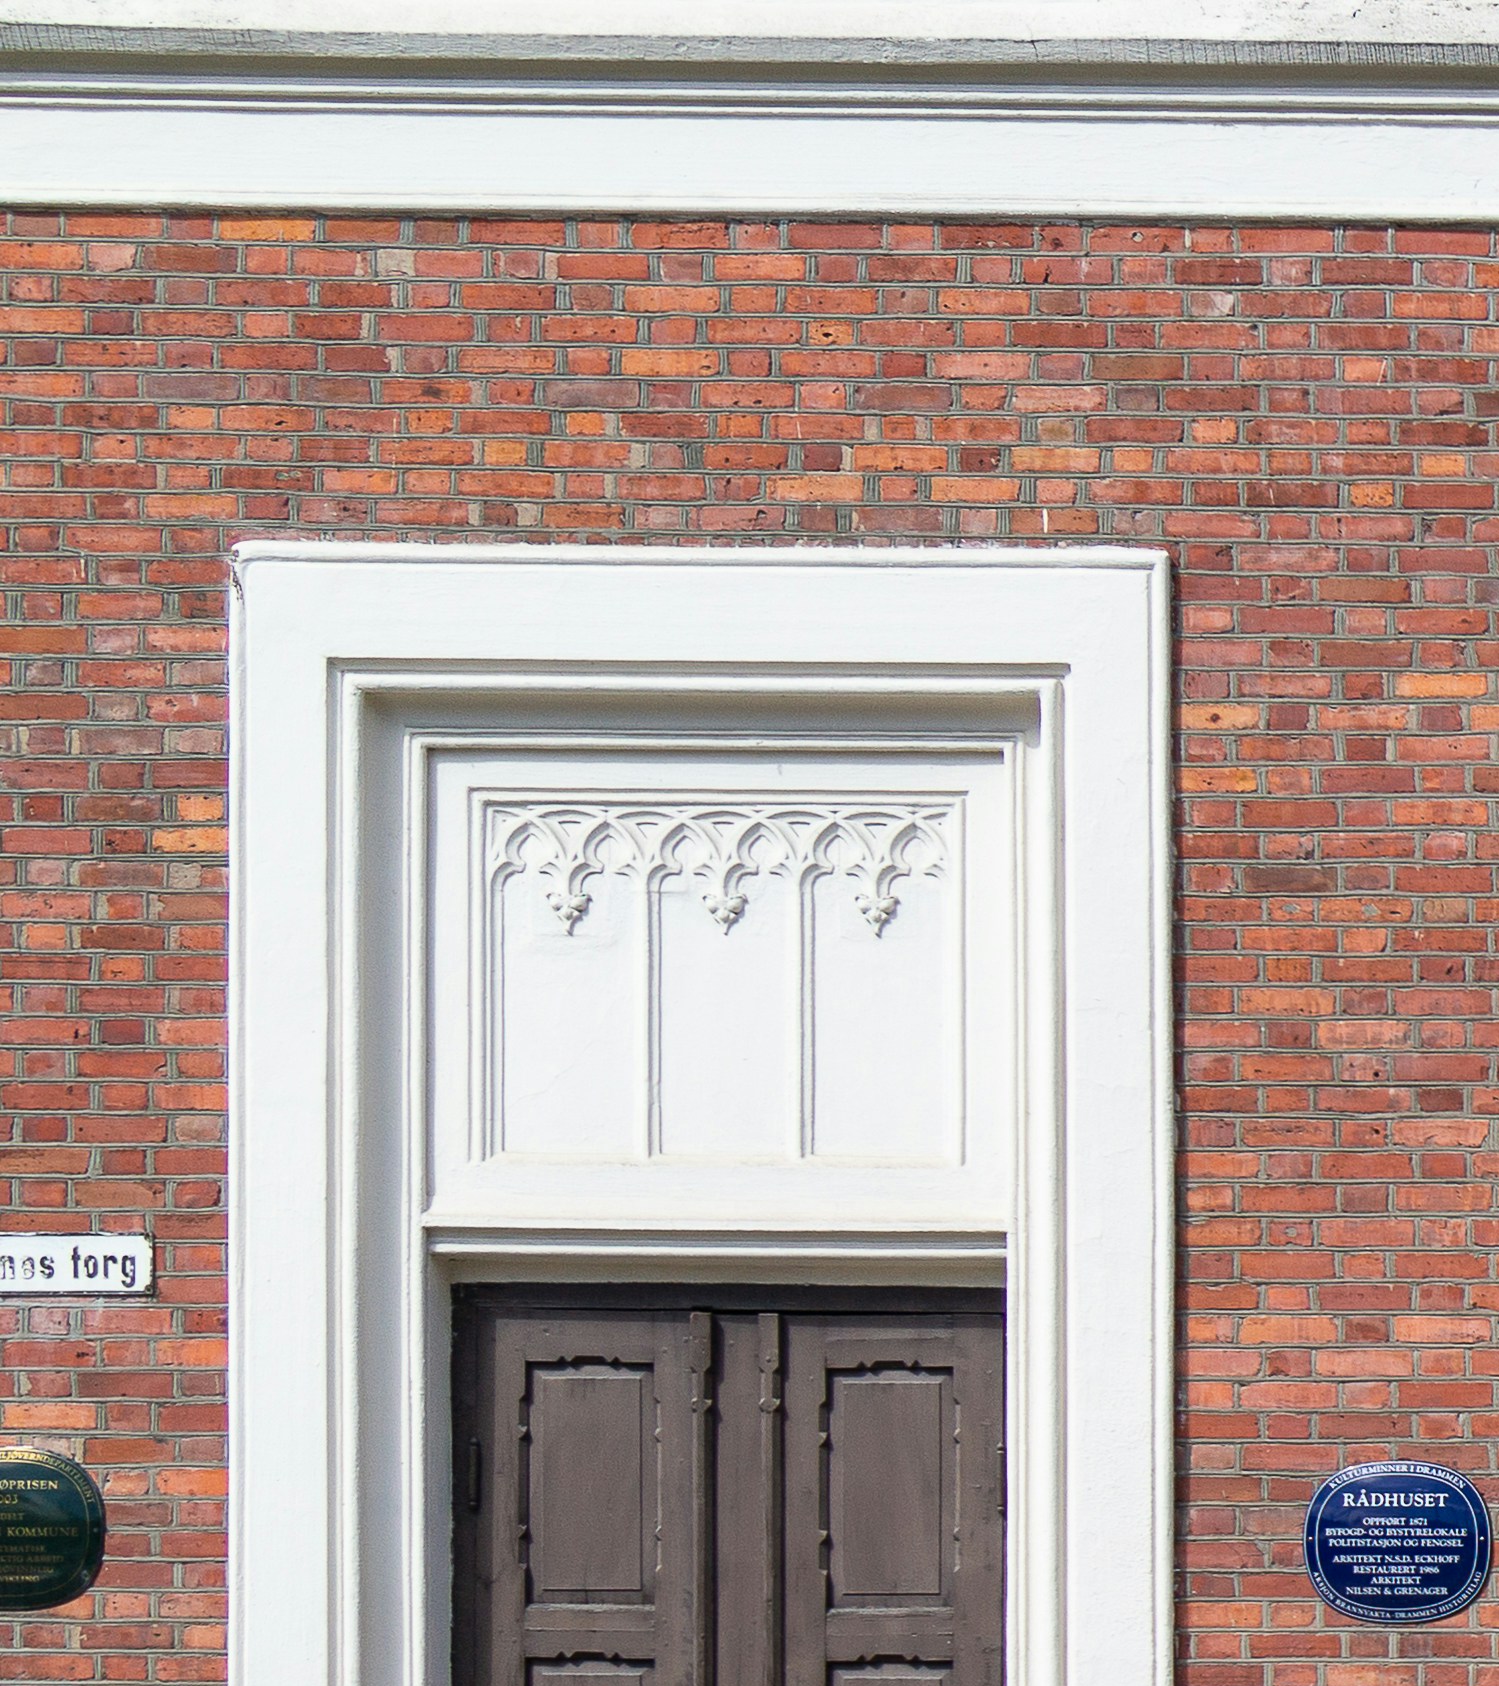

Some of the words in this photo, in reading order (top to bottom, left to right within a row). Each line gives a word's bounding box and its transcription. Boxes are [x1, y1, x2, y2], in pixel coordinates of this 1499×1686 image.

[71, 1245, 137, 1289] torg
[1328, 1465, 1408, 1489] KULTURMINNER
[1409, 1465, 1415, 1473] I
[1416, 1465, 1467, 1489] DRAMMEN
[1342, 1488, 1449, 1507] RÅDHUSET
[7, 1526, 80, 1537] KOMMUNE
[1325, 1527, 1368, 1537] BYFOGD-
[1368, 1527, 1384, 1537] OG
[1386, 1527, 1468, 1537] BYSTYRELOKALE
[1328, 1538, 1402, 1549] POLITISTASJON
[1403, 1538, 1419, 1547] OG
[1420, 1538, 1465, 1547] FENGSEL
[1332, 1554, 1383, 1563] ARKITEKT
[1414, 1554, 1460, 1563] ECKHOFF
[1353, 1565, 1417, 1574] RESTAURERT
[1370, 1576, 1422, 1585] ARKITEKT
[1345, 1586, 1381, 1595] NILSEN
[1383, 1587, 1392, 1595] &
[1393, 1586, 1449, 1595] GRENAGER
